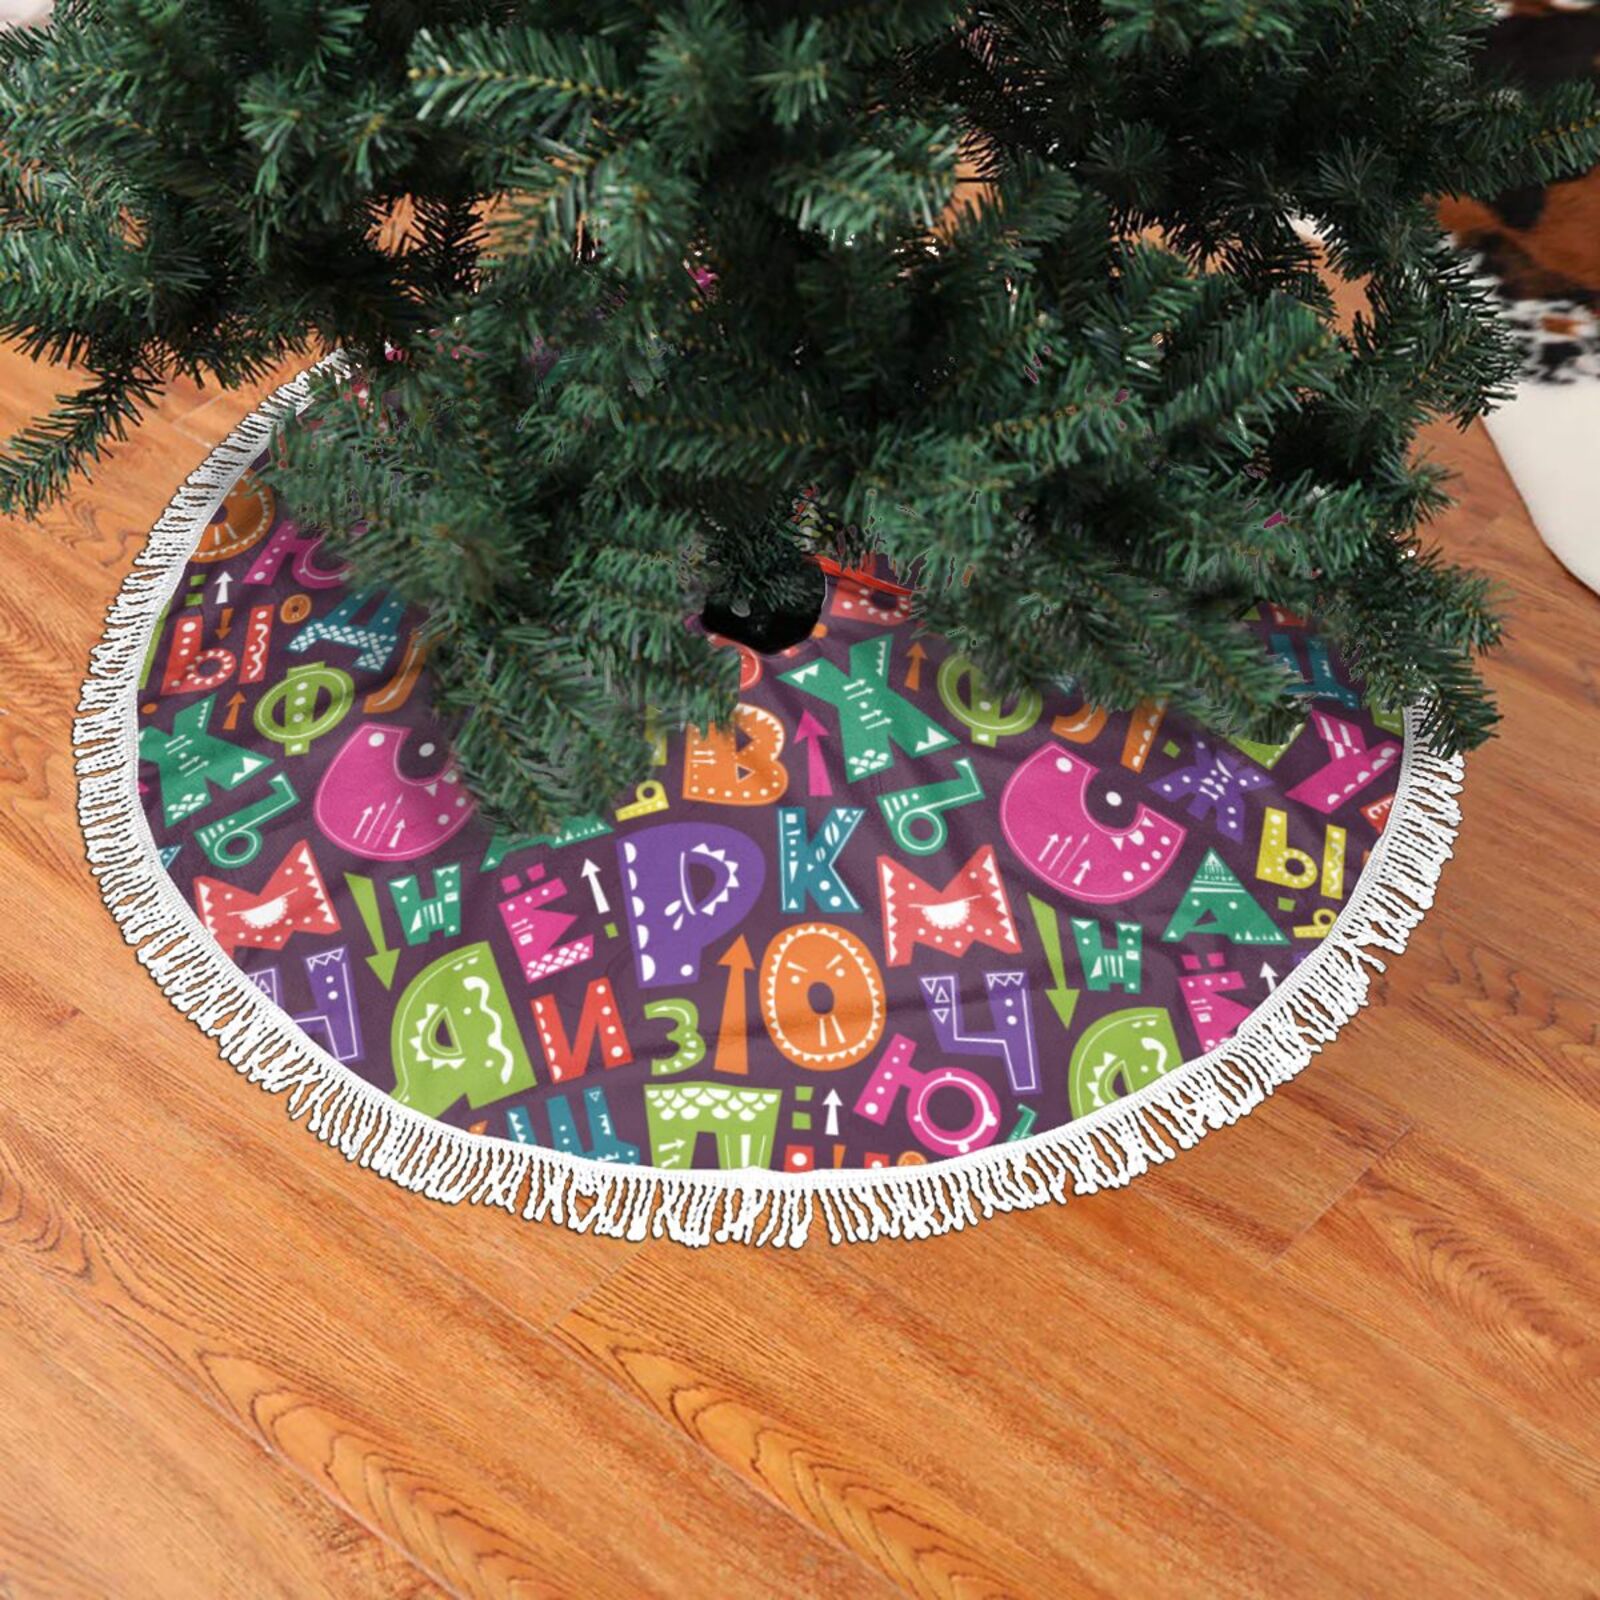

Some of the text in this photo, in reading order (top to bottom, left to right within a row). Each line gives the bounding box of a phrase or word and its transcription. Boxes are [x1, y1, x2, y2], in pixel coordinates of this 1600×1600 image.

[160, 604, 274, 695] Ы
[253, 662, 355, 757] Ф
[683, 702, 789, 806] В
[1285, 709, 1403, 814] У
[778, 806, 868, 915] К
[1001, 741, 1188, 904] С
[1255, 806, 1347, 900] Ы
[193, 838, 342, 961] М
[388, 861, 461, 946] Н
[498, 862, 595, 984] Ё
[616, 821, 767, 989] Р
[876, 844, 1023, 968] М
[1161, 847, 1292, 946] А
[759, 921, 887, 1072] О
[1071, 917, 1143, 995] Н
[530, 976, 634, 1085] И
[918, 970, 1043, 1096] Ч
[853, 1032, 1001, 1158] Ю
